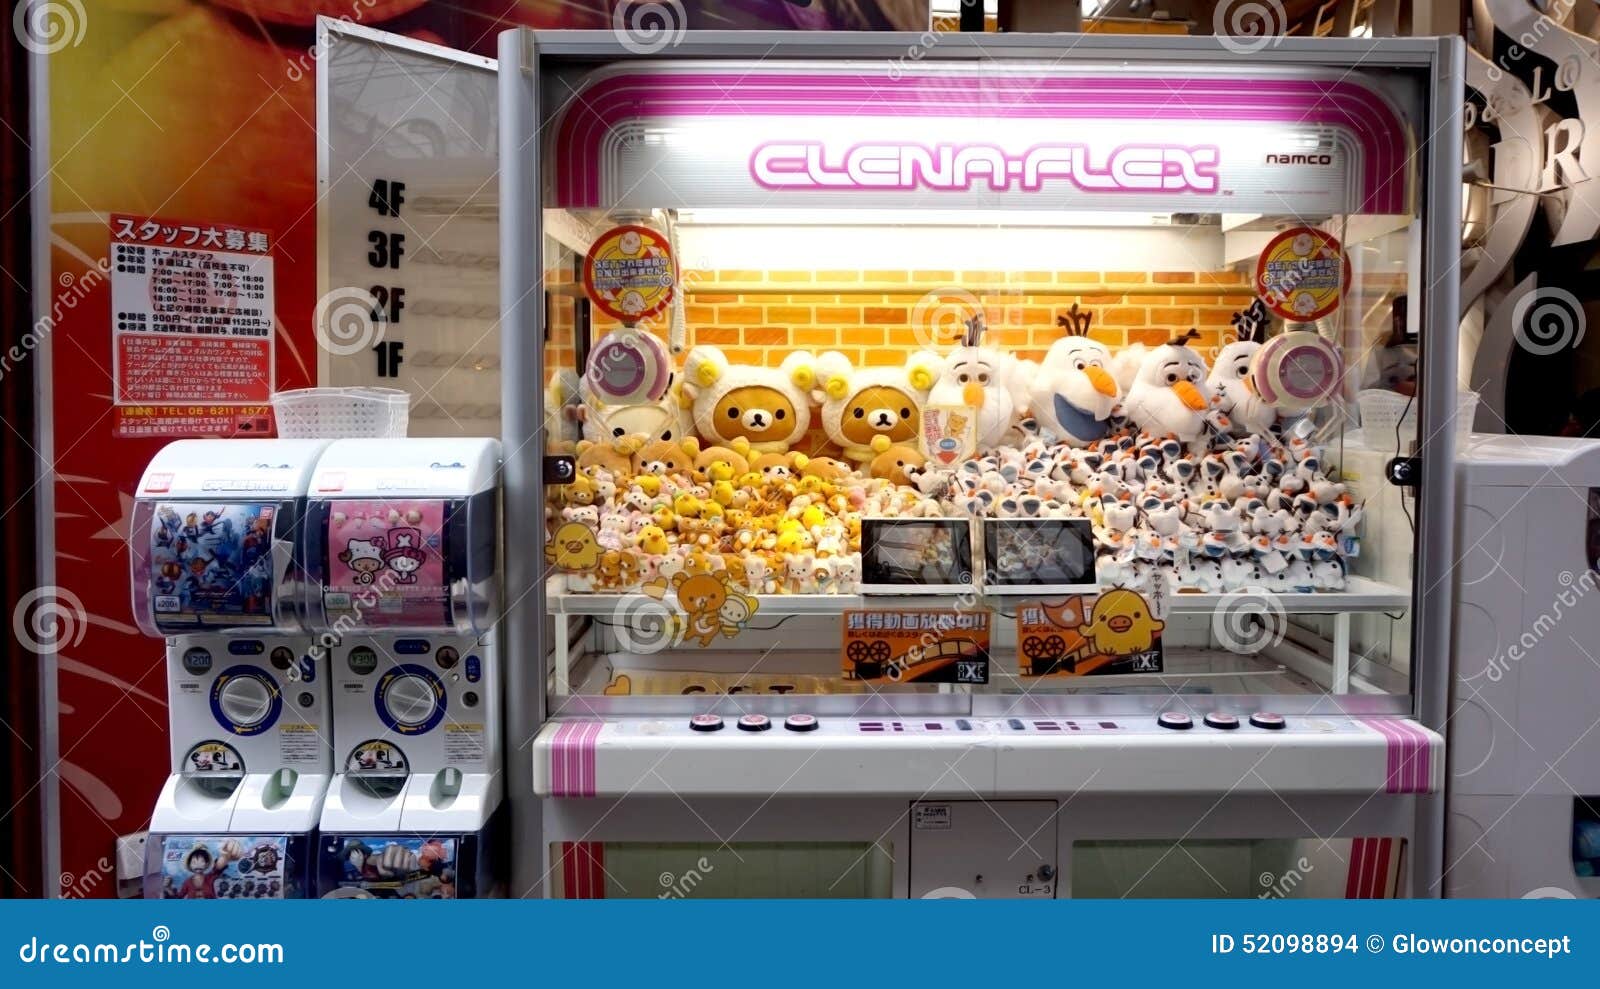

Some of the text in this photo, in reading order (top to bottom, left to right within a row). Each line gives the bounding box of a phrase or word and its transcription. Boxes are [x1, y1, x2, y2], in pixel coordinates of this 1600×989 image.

[1266, 154, 1332, 165] namco
[368, 179, 405, 217] 4F
[115, 219, 269, 252] スタッフ大募集
[368, 230, 405, 269] 3F
[370, 285, 405, 323] 2F
[372, 341, 403, 377] 1F
